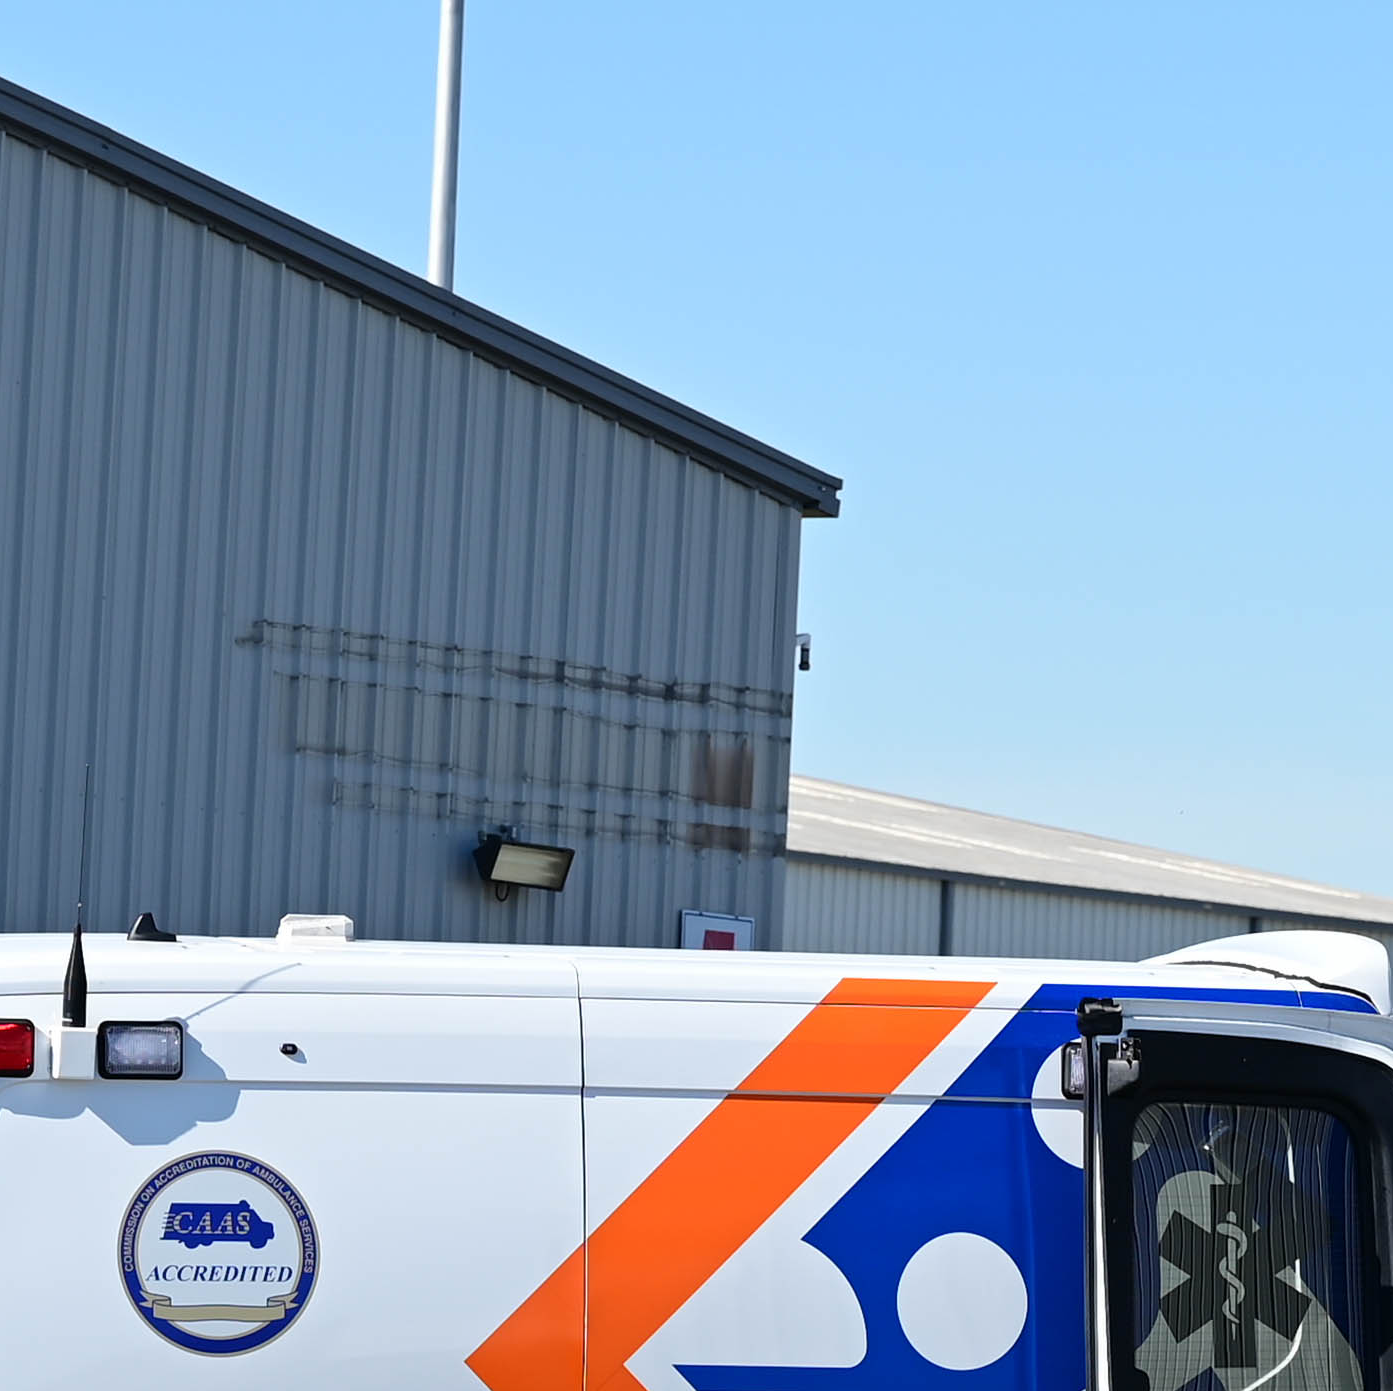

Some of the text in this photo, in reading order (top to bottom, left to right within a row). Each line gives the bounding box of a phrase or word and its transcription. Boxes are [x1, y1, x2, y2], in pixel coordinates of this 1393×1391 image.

[123, 1156, 315, 1273] COMMISSION ON ACCREDITATION OF AMBULANCE SERVICES
[172, 1211, 251, 1235] CAAS
[145, 1264, 294, 1283] ACCREDITED
